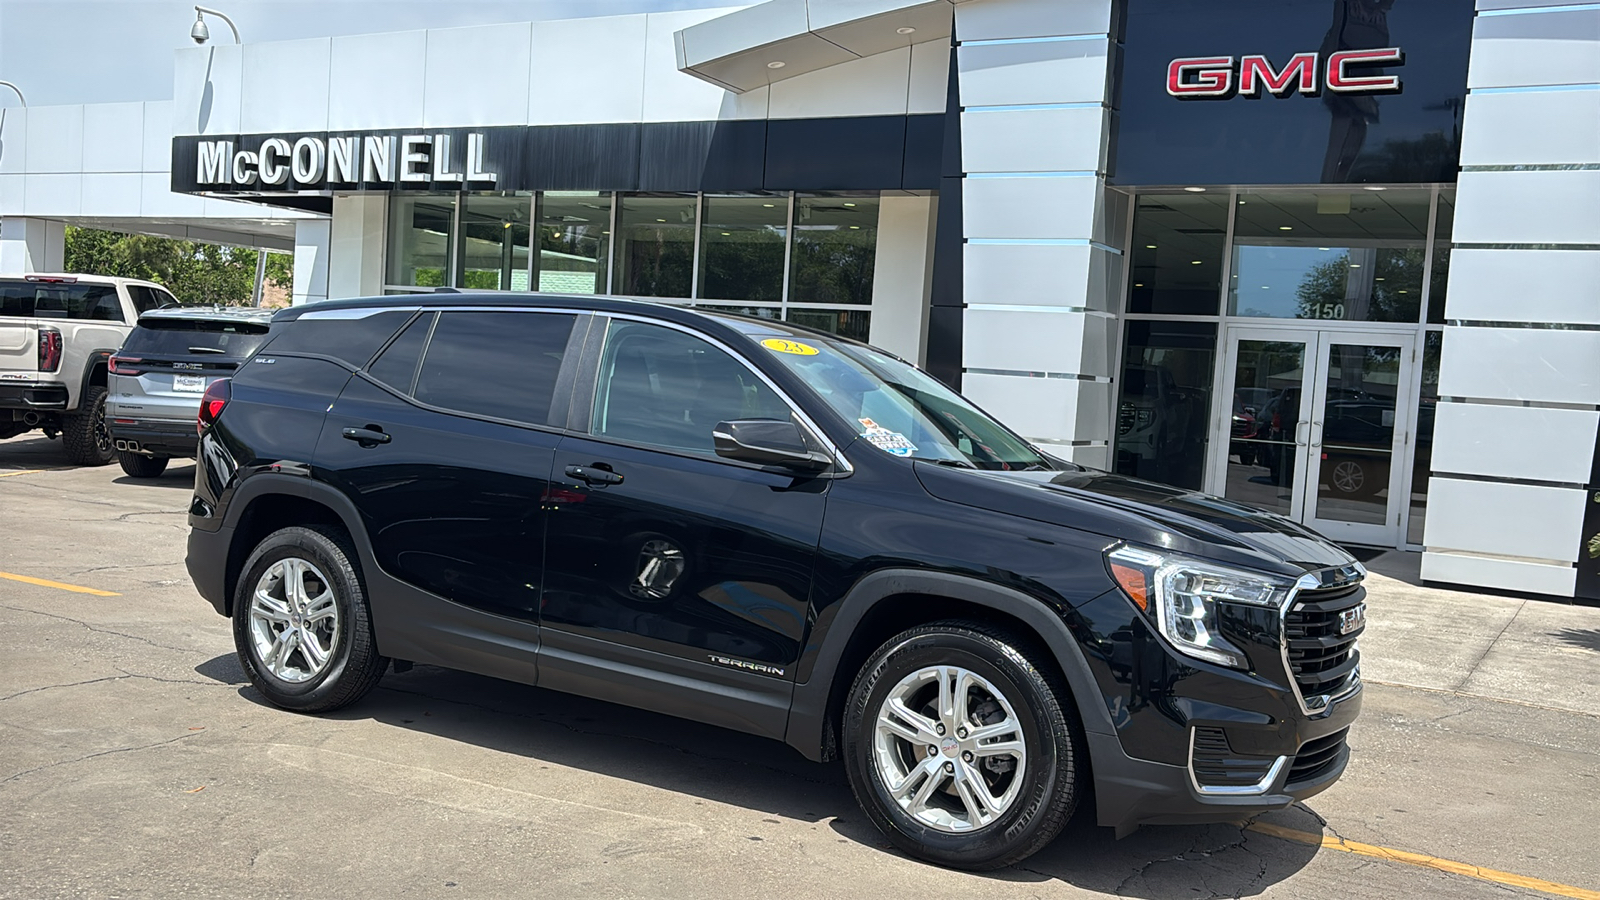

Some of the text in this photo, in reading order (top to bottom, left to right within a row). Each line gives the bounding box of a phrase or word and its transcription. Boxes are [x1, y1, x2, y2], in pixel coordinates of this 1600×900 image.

[1166, 47, 1401, 96] GMC
[196, 133, 497, 185] McCONNELL
[1300, 303, 1345, 319] 3150
[778, 340, 803, 353] 23
[172, 362, 203, 370] GMC
[707, 654, 785, 676] TERRAIN
